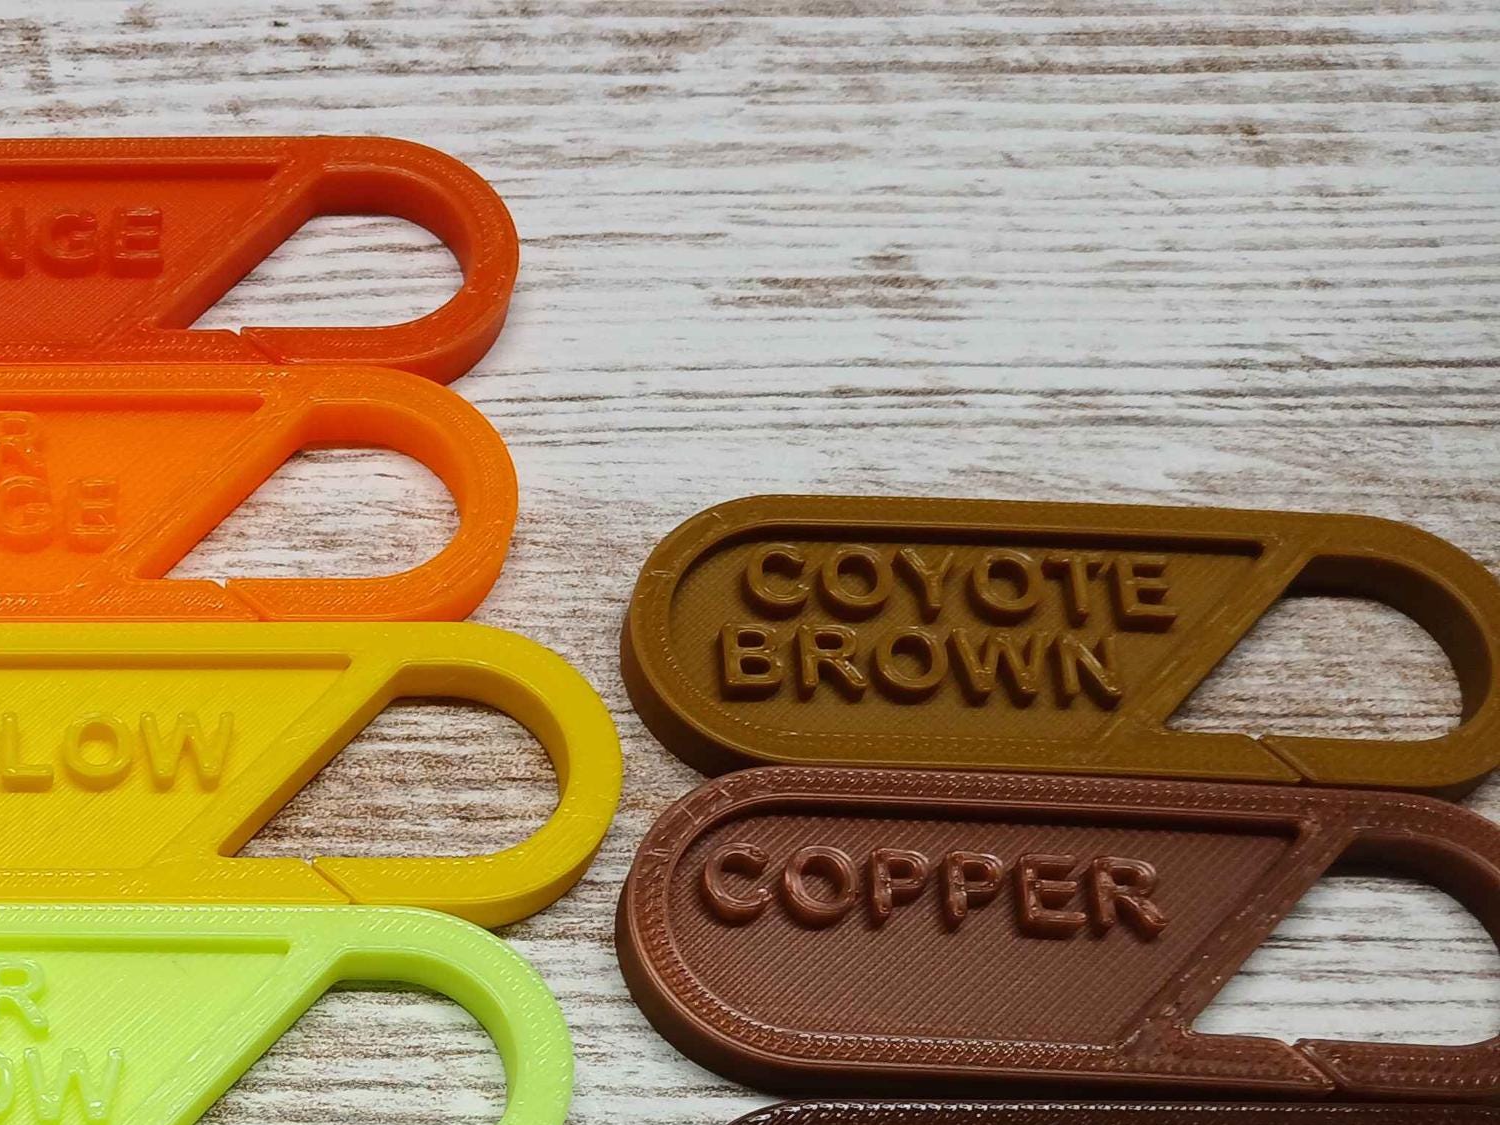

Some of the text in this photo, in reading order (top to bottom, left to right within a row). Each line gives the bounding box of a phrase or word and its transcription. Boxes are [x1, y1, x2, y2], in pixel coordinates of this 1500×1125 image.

[742, 542, 1180, 632] COYOTE
[716, 620, 1124, 709] BROWN
[702, 841, 1170, 940] COPPER
